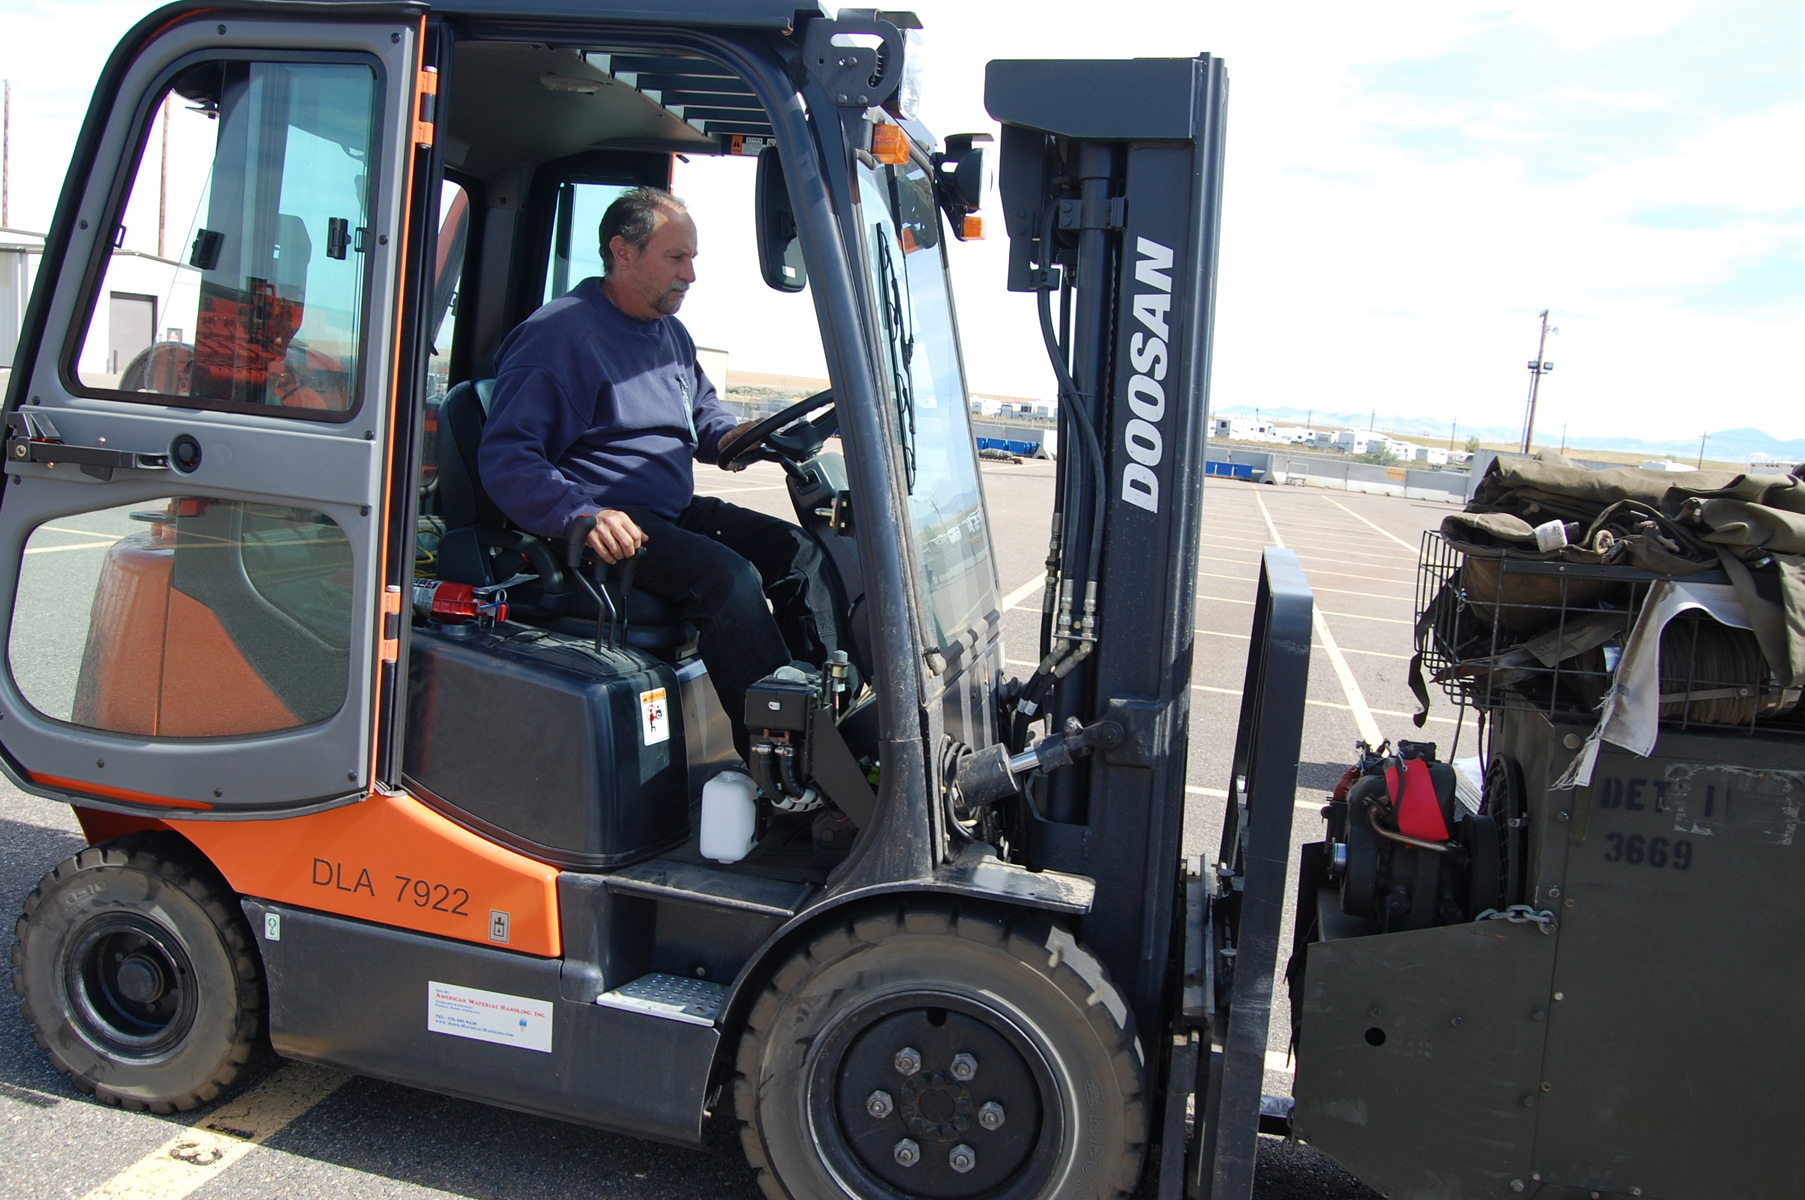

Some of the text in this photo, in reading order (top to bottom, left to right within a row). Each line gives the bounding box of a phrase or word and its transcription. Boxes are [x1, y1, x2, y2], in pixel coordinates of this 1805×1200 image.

[1122, 236, 1174, 514] DOOSAN
[1600, 777, 1671, 813] DET
[1604, 832, 1693, 871] 3669
[312, 857, 469, 917] DLA 7922
[435, 993, 467, 1003] AMERICAN
[468, 999, 499, 1009] MATERIAL
